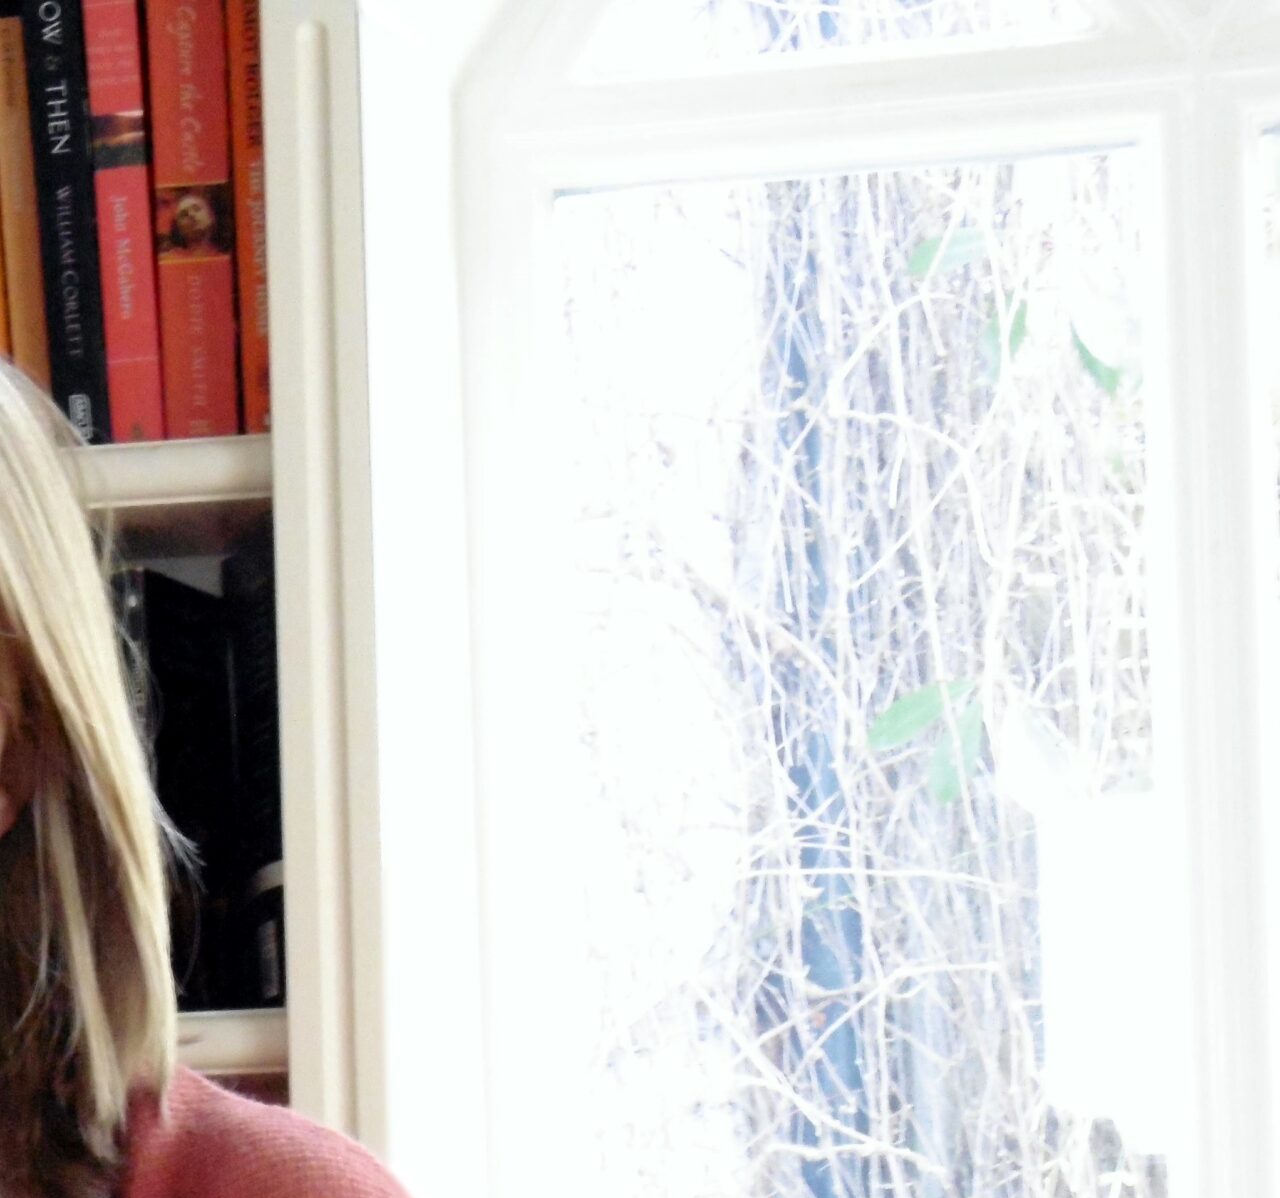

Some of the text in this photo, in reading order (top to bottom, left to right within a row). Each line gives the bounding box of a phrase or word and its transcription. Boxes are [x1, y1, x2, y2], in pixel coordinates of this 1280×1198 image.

[44, 80, 71, 154] THEN
[179, 84, 203, 110] the
[244, 64, 261, 148] BOLGER
[179, 117, 203, 174] Castle
[248, 159, 265, 196] THE
[54, 184, 76, 264] WILLIAM
[108, 194, 136, 320] John McGahern
[249, 199, 268, 278] JOURNEY
[60, 270, 84, 358] CORLETT
[187, 275, 203, 334] DODIE
[190, 346, 208, 407] SMITH
